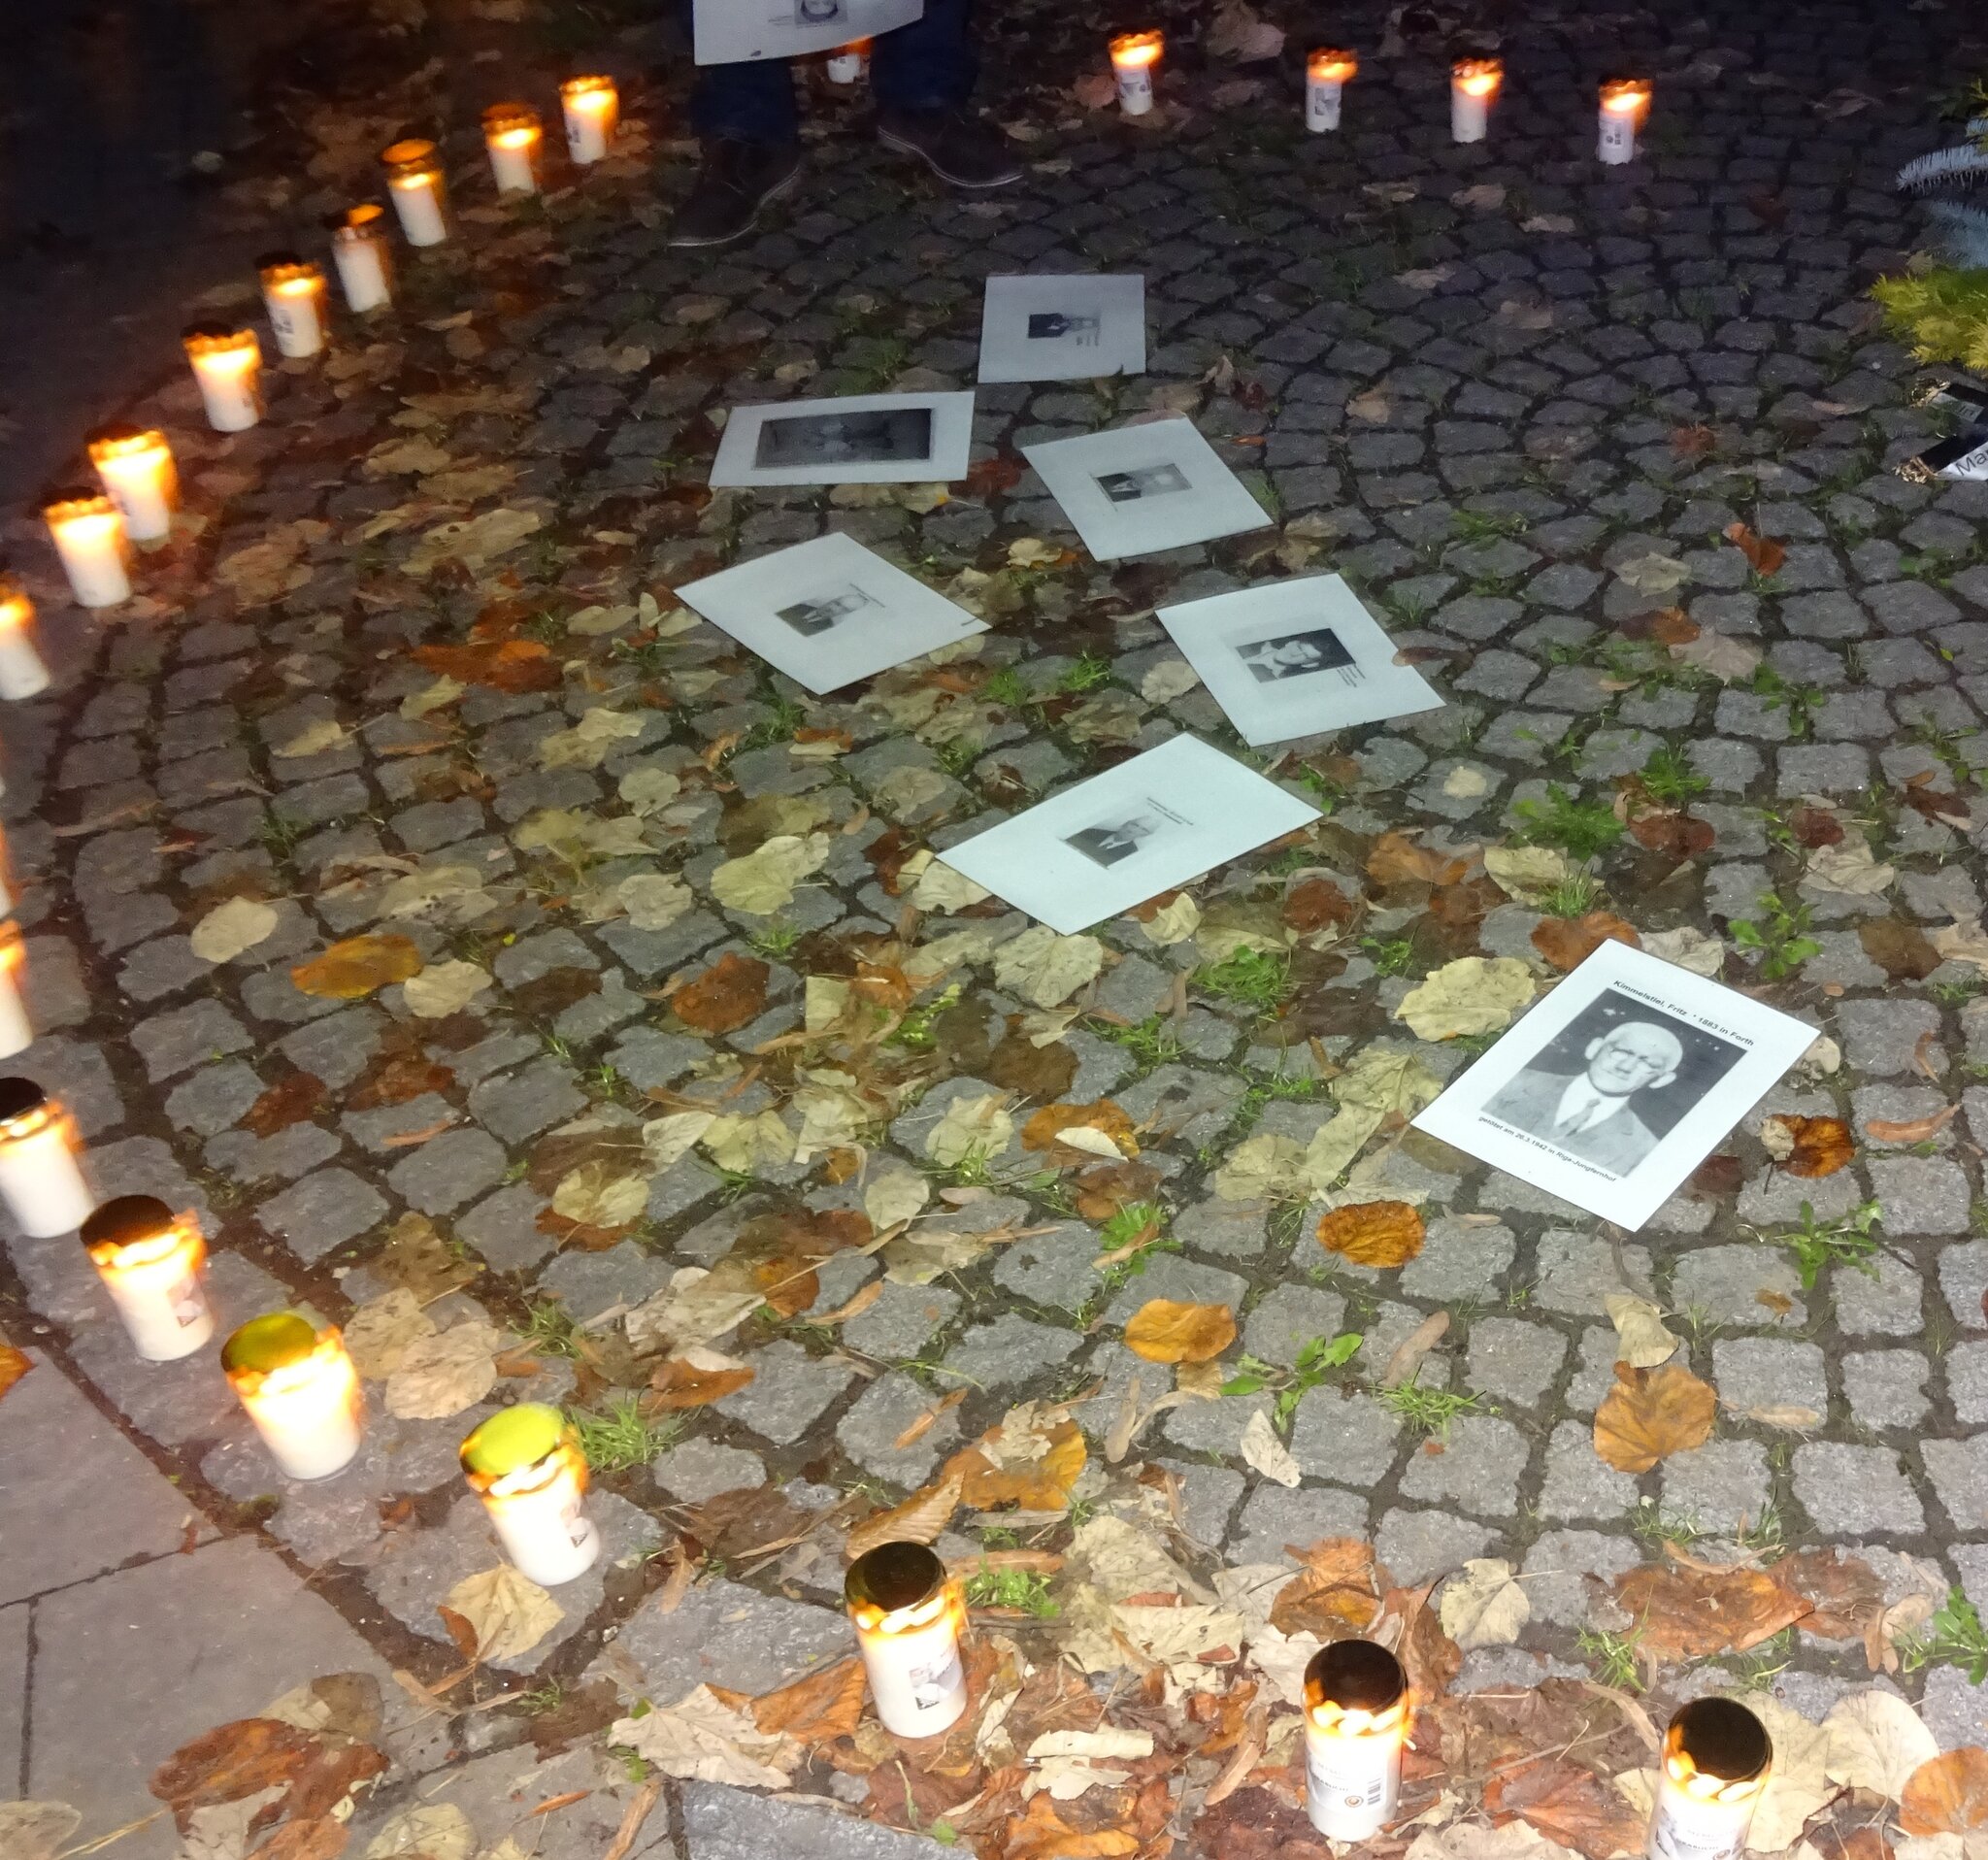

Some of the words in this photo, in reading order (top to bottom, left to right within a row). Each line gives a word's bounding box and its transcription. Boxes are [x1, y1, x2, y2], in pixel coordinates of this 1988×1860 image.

[1955, 449, 1988, 477] Ma
[1612, 980, 1665, 1007] Kimmelstiel,
[1667, 1004, 1688, 1016] Fritz
[1698, 1017, 1719, 1030] 1883
[1719, 1026, 1729, 1035] in
[1730, 1031, 1755, 1046] Forth
[1504, 1127, 1514, 1136] am
